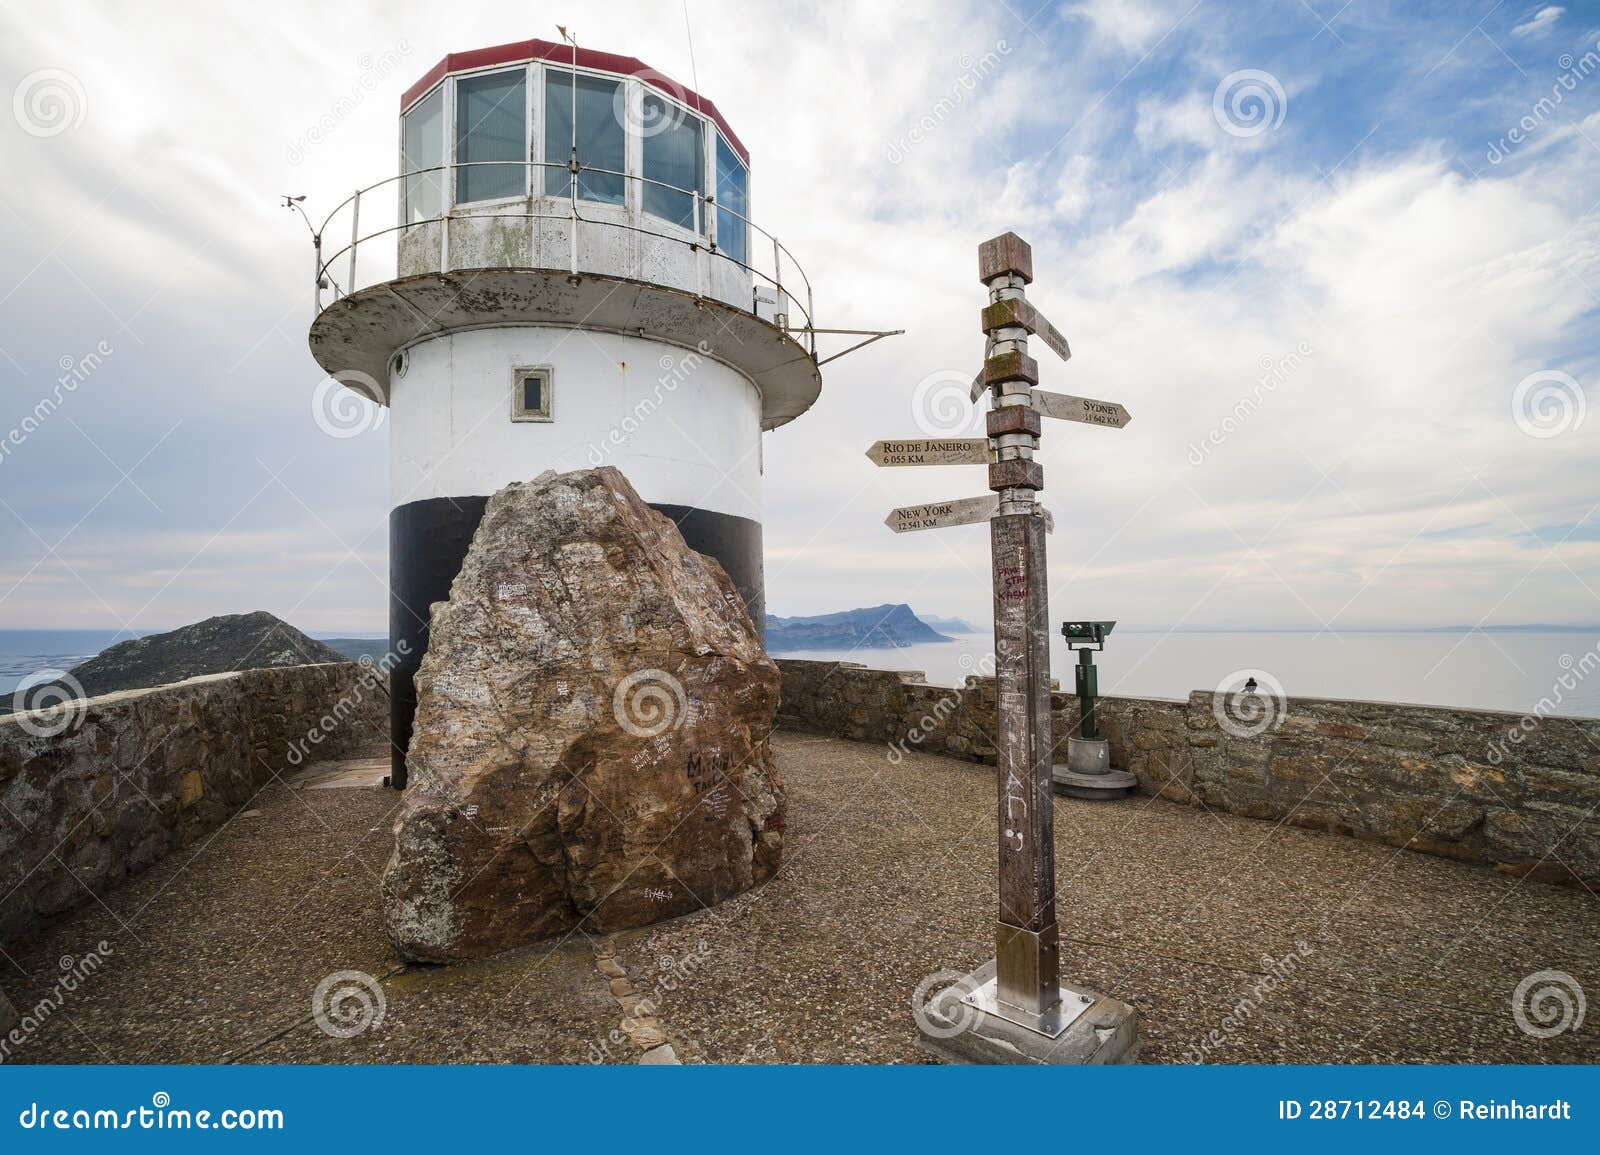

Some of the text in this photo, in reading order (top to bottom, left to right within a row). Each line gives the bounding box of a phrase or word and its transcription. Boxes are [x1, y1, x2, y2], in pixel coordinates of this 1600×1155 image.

[1083, 400, 1119, 415] SYDNEY
[1107, 416, 1120, 426] KM
[883, 440, 971, 453] RIO DE JANEIRO
[883, 455, 889, 464] 6
[891, 455, 906, 463] 055
[908, 454, 924, 463] KM
[897, 504, 953, 520] NEW YORK
[909, 520, 921, 529] 541
[922, 518, 937, 527] KM
